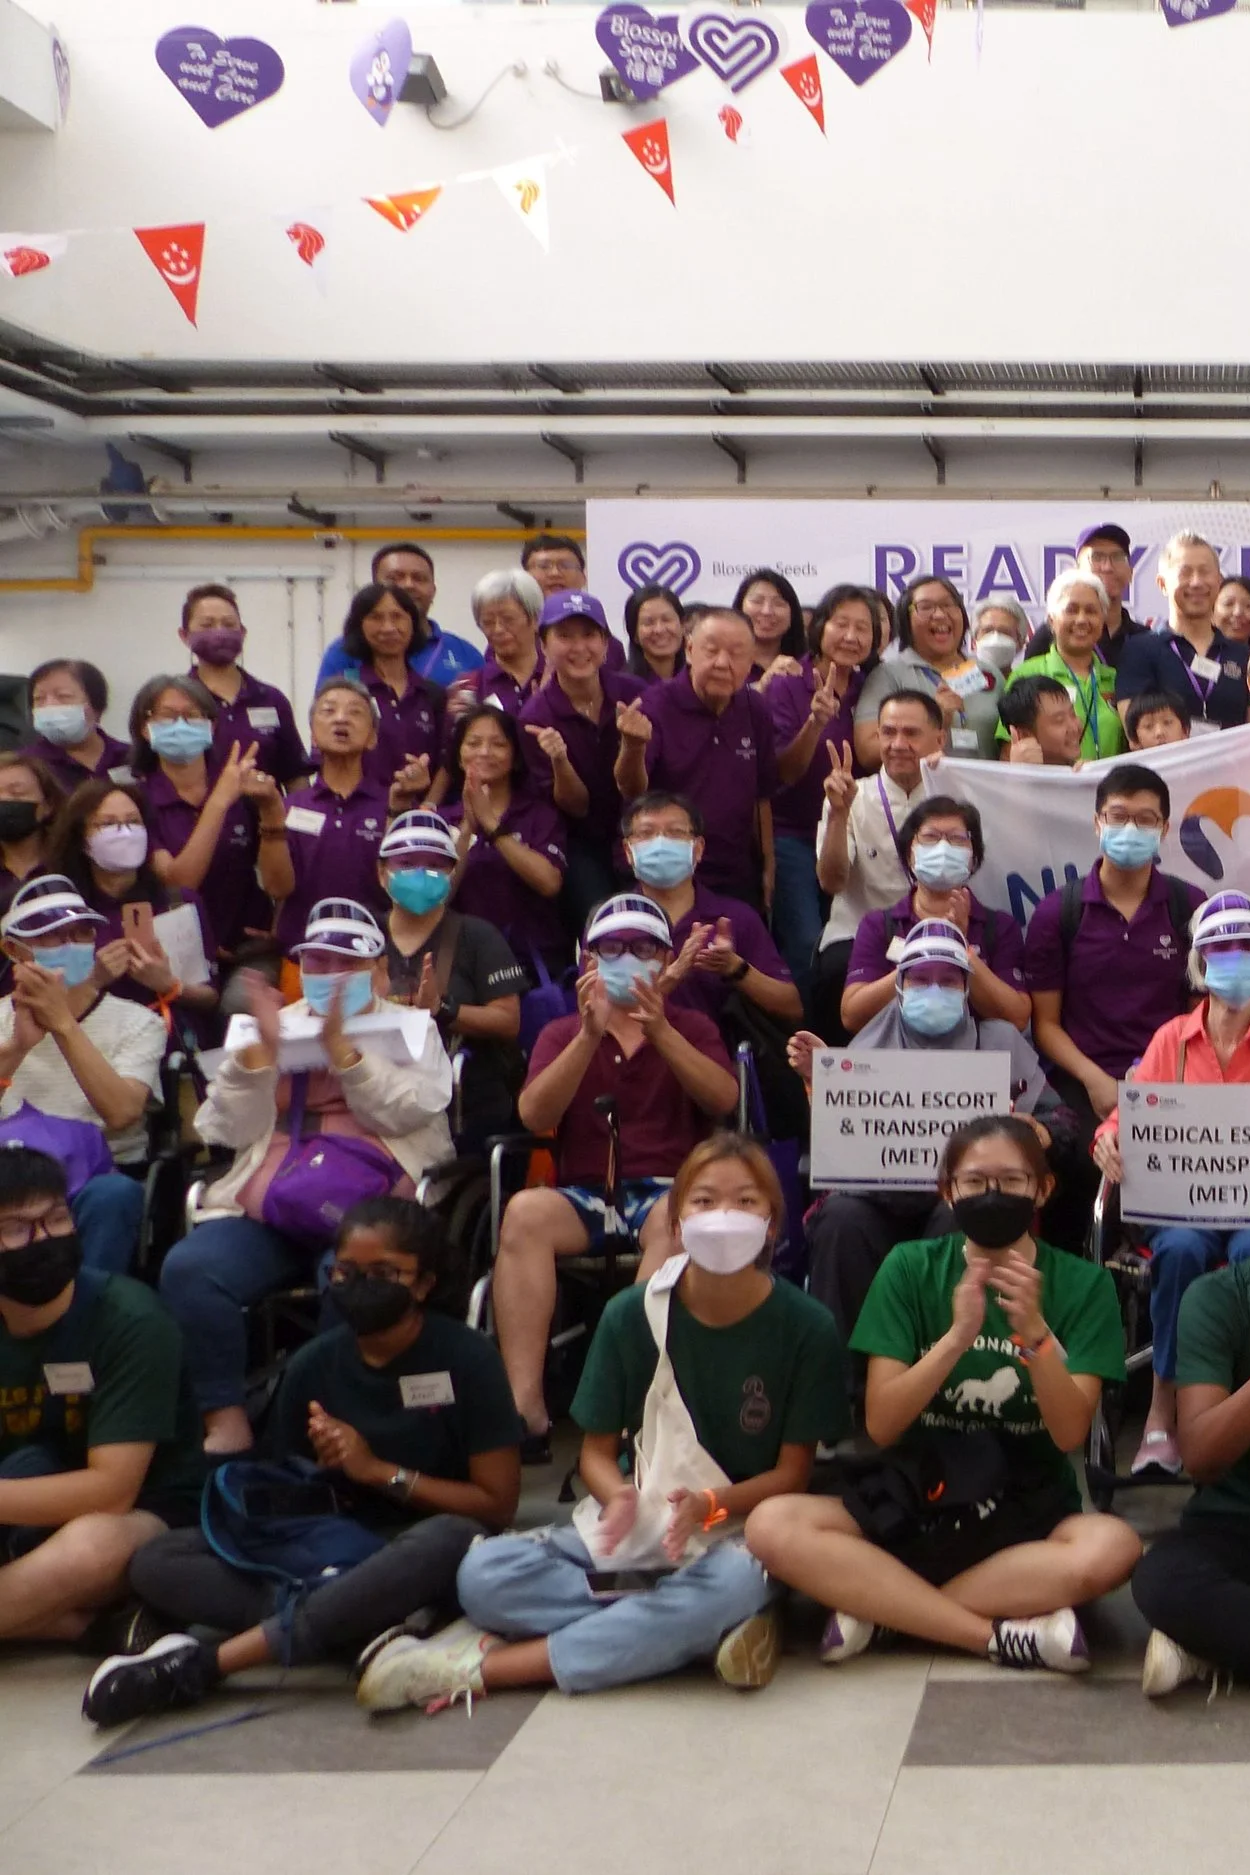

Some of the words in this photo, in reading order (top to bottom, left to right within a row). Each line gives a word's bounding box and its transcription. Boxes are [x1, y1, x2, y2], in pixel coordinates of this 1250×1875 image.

[618, 37, 677, 70] Seeds
[712, 560, 774, 577] Blosso
[776, 560, 818, 577] Seeds
[825, 1089, 915, 1109] MEDICAL
[921, 1091, 998, 1110] ESCORT
[840, 1119, 855, 1136] &
[862, 1118, 969, 1138] TRANSPO
[1131, 1124, 1224, 1145] MEDICAL
[881, 1146, 939, 1168] (MET)
[1147, 1155, 1162, 1173] &
[1189, 1183, 1249, 1206] (MET)
